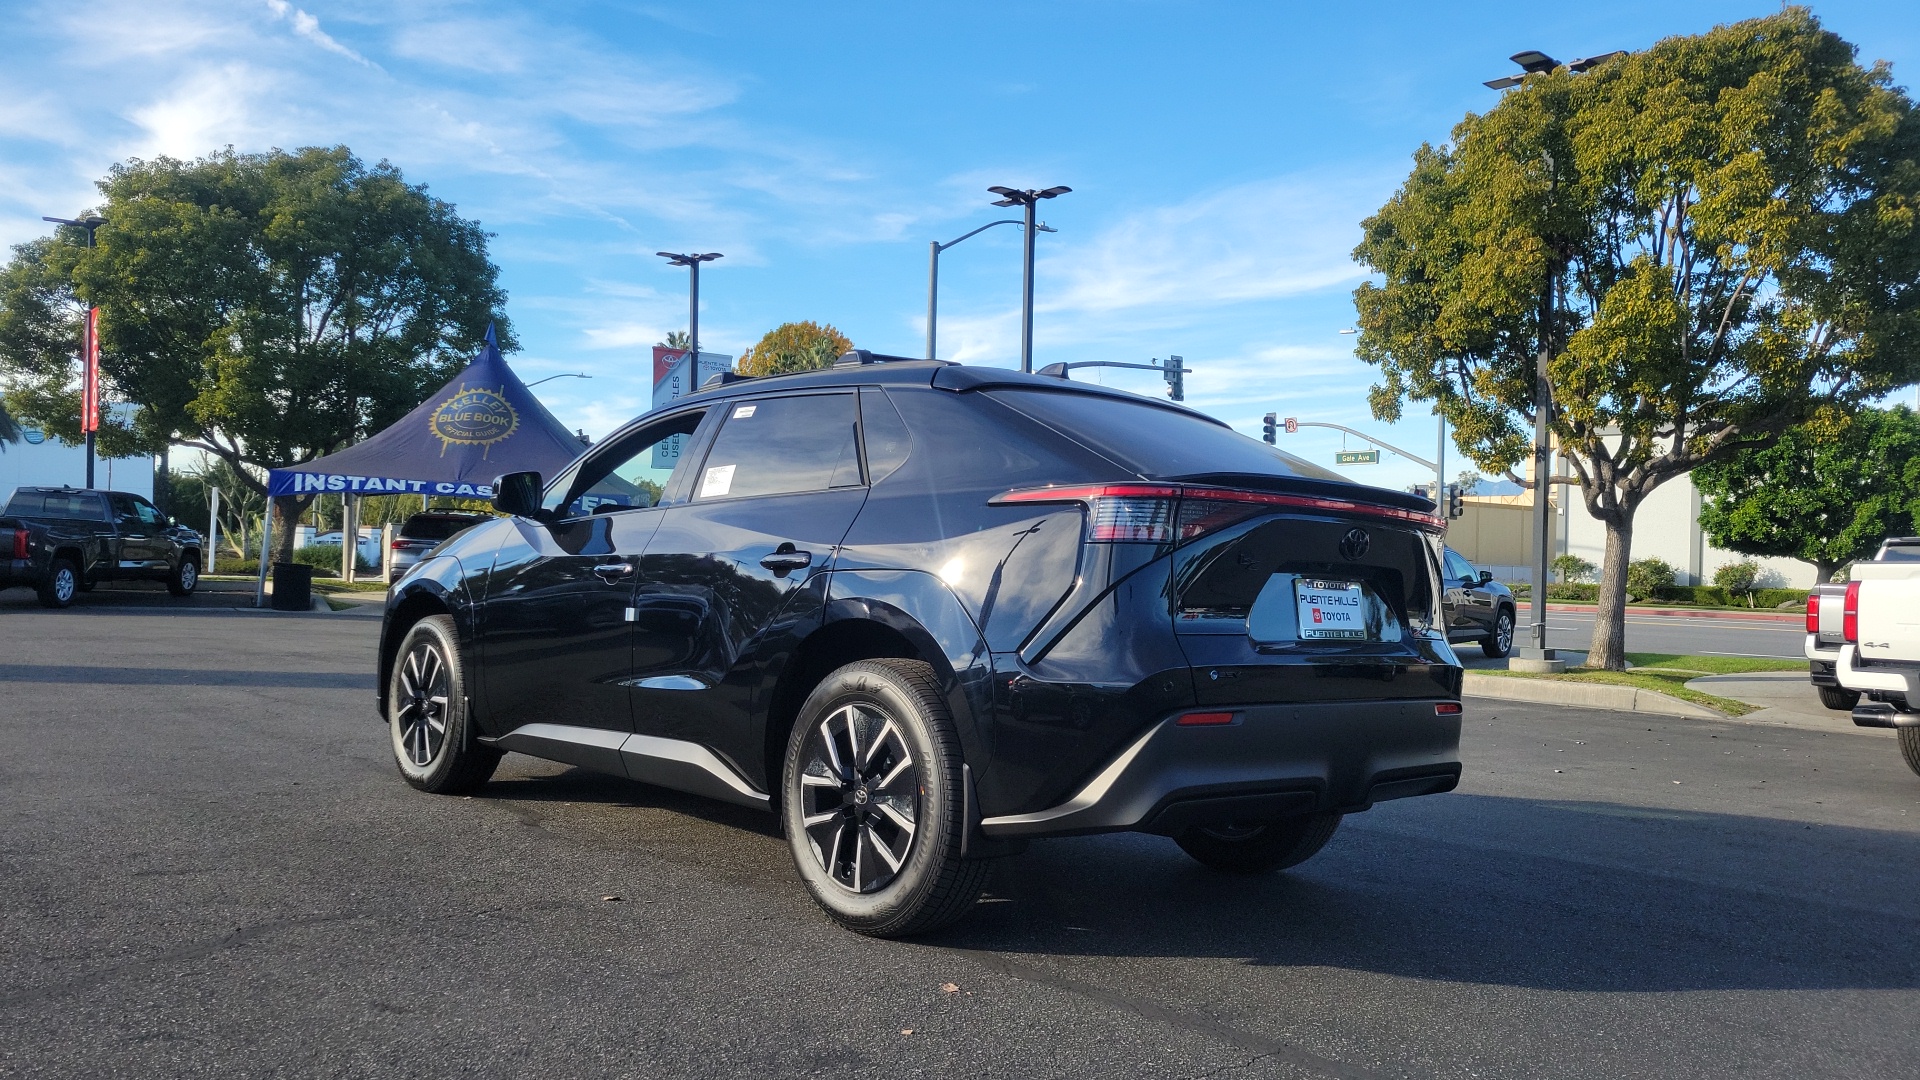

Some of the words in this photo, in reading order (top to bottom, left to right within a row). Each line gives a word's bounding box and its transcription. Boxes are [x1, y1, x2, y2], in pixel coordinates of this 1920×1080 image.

[450, 395, 507, 413] KELLEY
[439, 412, 472, 422] BLUE
[474, 413, 509, 426] BOOK
[443, 425, 473, 436] OFFICIAL
[475, 427, 499, 437] GUIDE
[294, 473, 426, 492] INSTANT
[435, 482, 493, 496] CAS
[1313, 581, 1346, 589] TOYOTA
[1300, 594, 1333, 605] PUENTE
[1334, 596, 1358, 606] HILLS
[1322, 611, 1351, 621] TOYOTA
